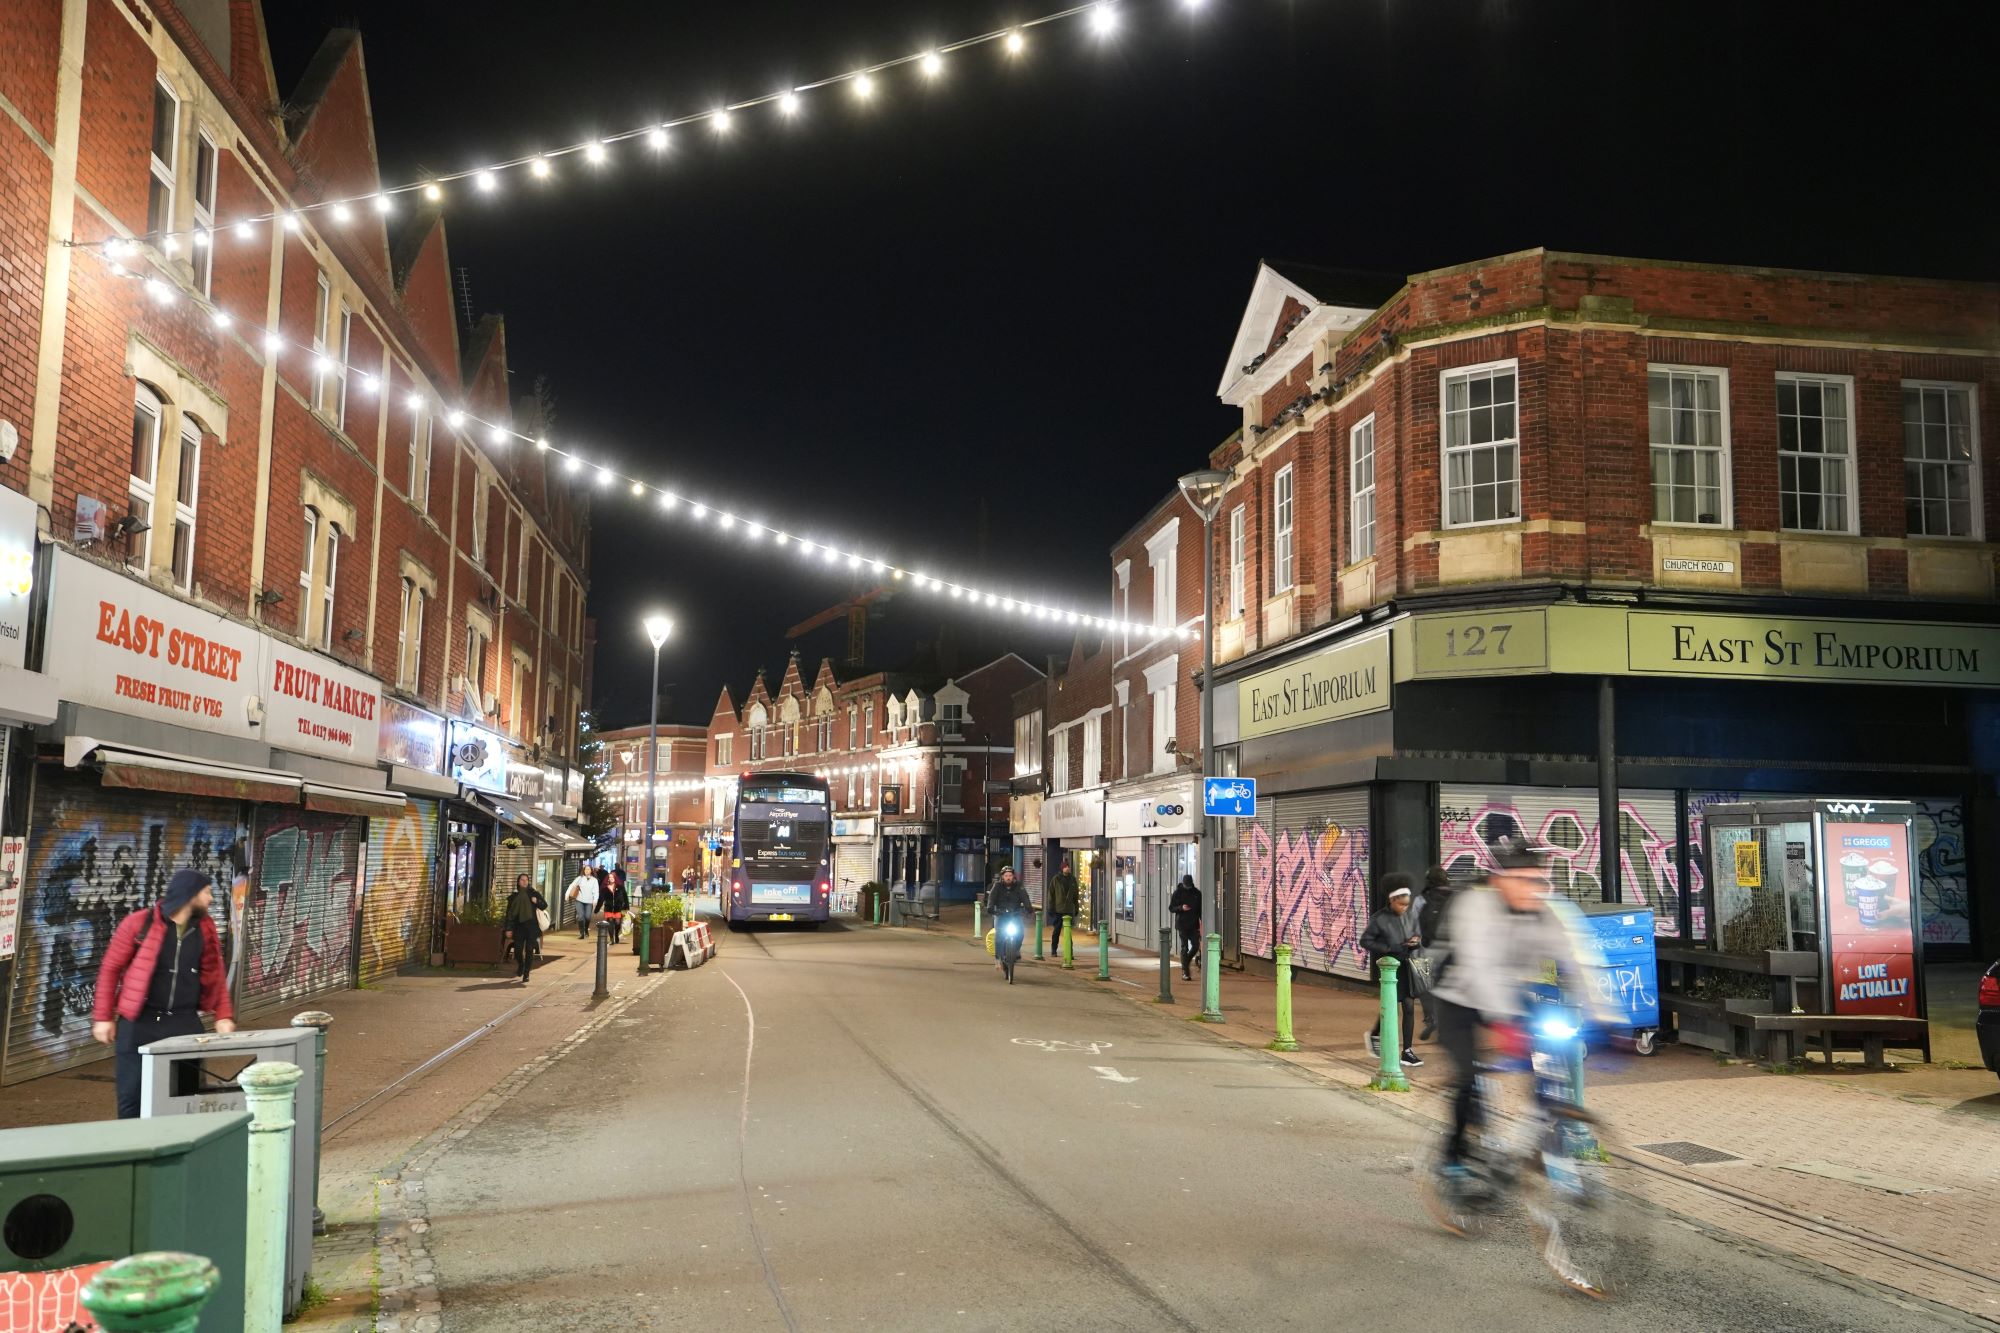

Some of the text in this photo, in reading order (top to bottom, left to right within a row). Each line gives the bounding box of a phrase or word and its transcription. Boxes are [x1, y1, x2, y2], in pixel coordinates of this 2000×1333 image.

[1665, 560, 1725, 572] CHURCH ROAD
[96, 600, 242, 683] EAST STREET
[1445, 624, 1513, 658] 127
[115, 674, 223, 719] FRESH FRUIT & VEG
[274, 659, 376, 721] FRUIT MARKET
[297, 716, 312, 736] TEL
[312, 722, 327, 741] 0117
[1157, 805, 1184, 816] TSB
[4, 842, 23, 855] SHOP
[1852, 837, 1889, 847] GREGGS
[757, 849, 778, 857] Express
[763, 887, 782, 896] take
[1857, 963, 1887, 980] LOVE
[1840, 977, 1908, 1001] ACTUALLY
